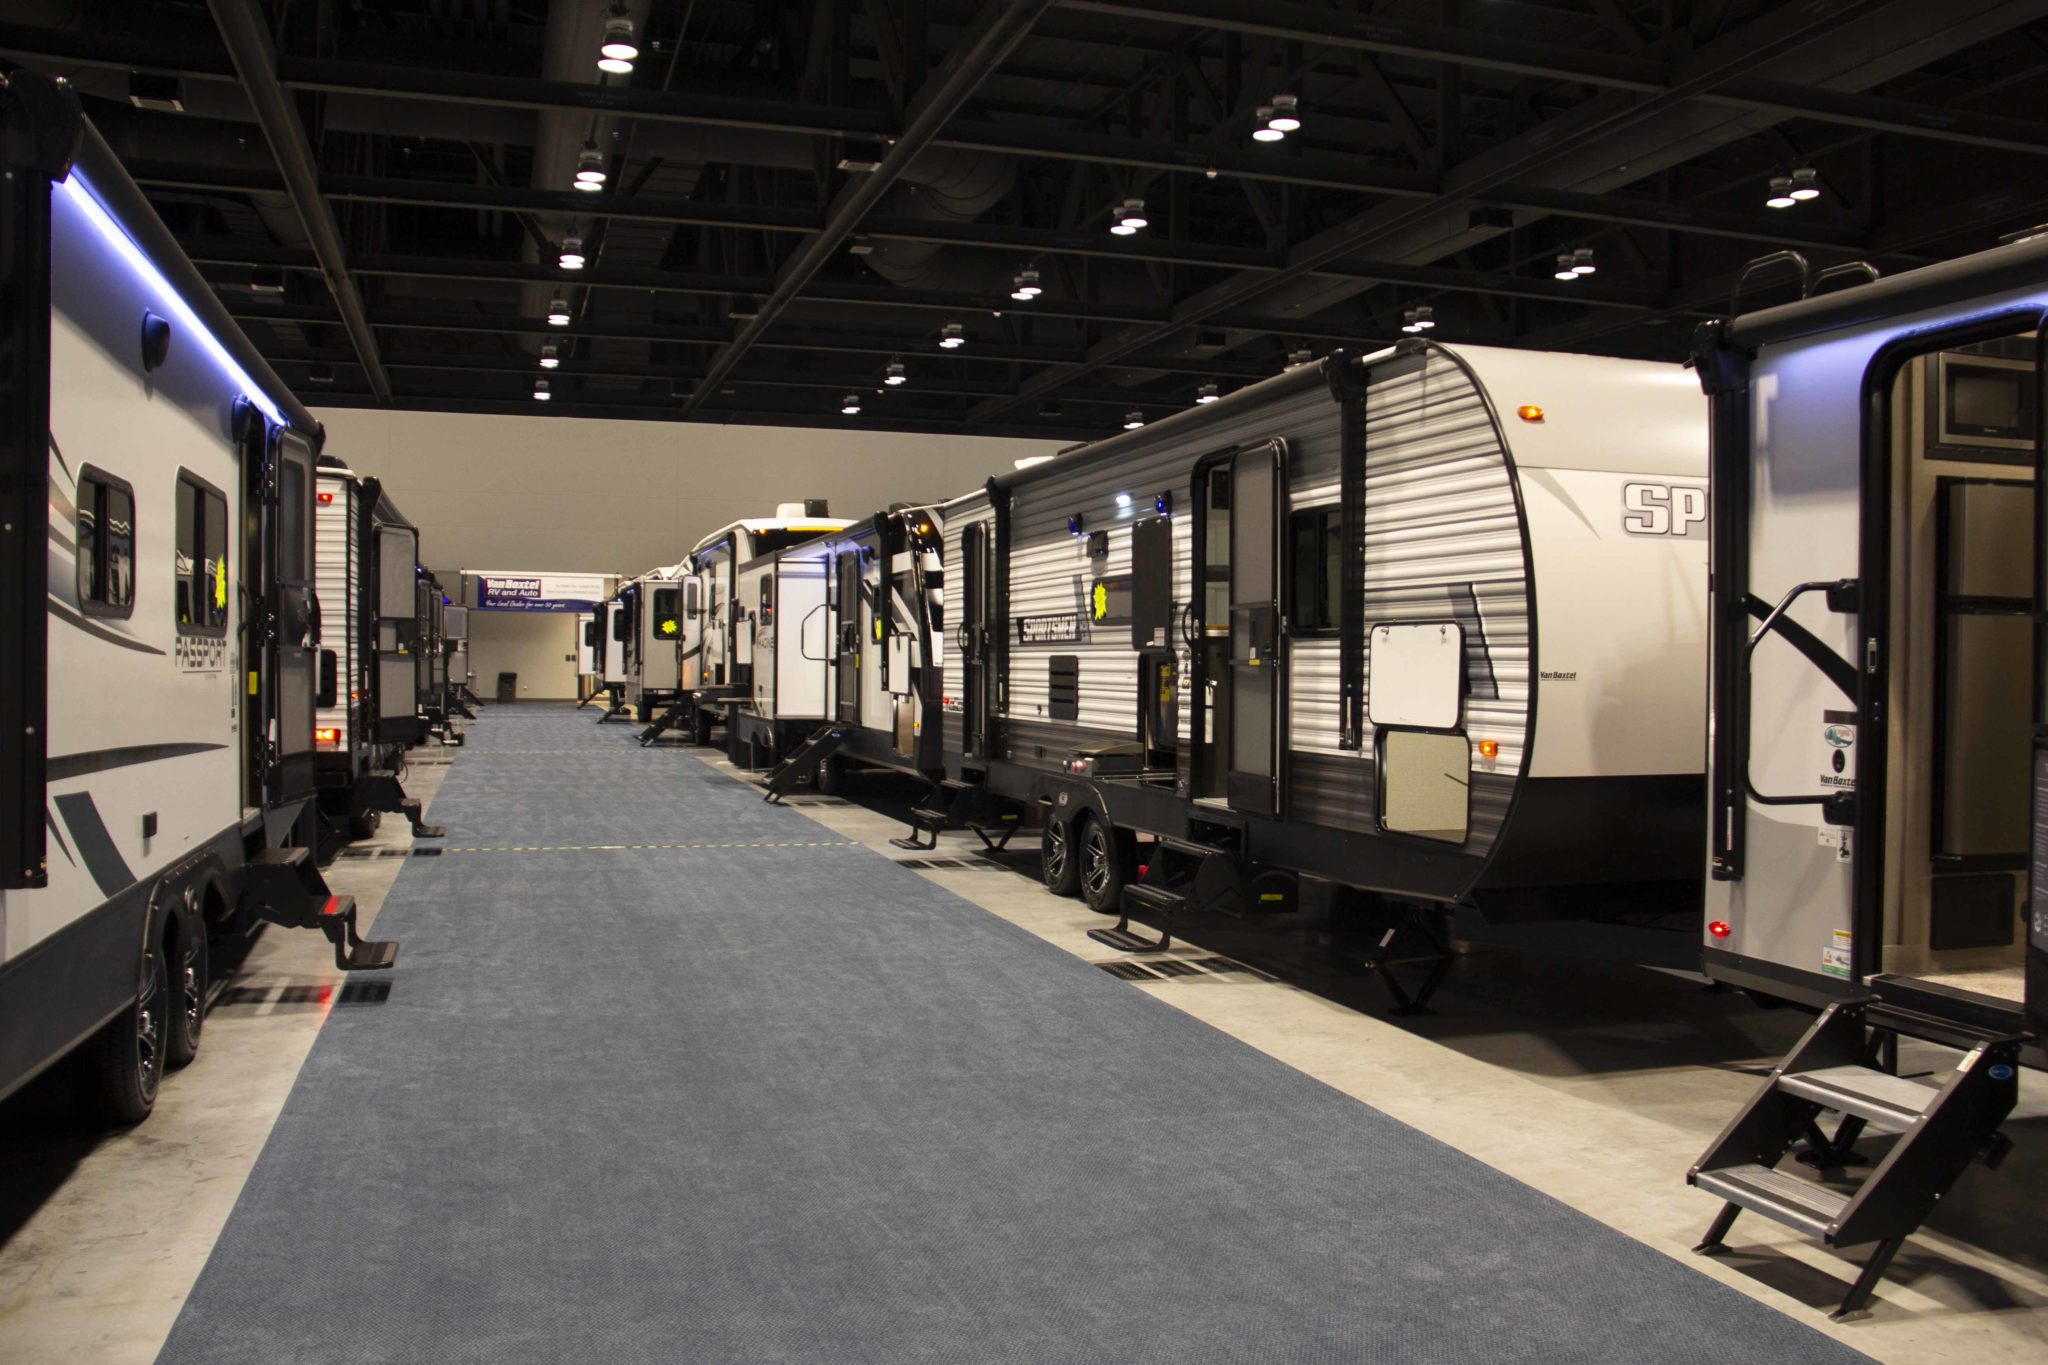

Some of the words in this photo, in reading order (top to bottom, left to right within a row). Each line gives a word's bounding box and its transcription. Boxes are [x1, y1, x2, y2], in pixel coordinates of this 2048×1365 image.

[487, 579, 505, 588] Van
[506, 580, 540, 590] Boxtel
[175, 636, 227, 667] PASSPORT
[1820, 774, 1832, 784] Van
[1833, 776, 1857, 786] Boxte
